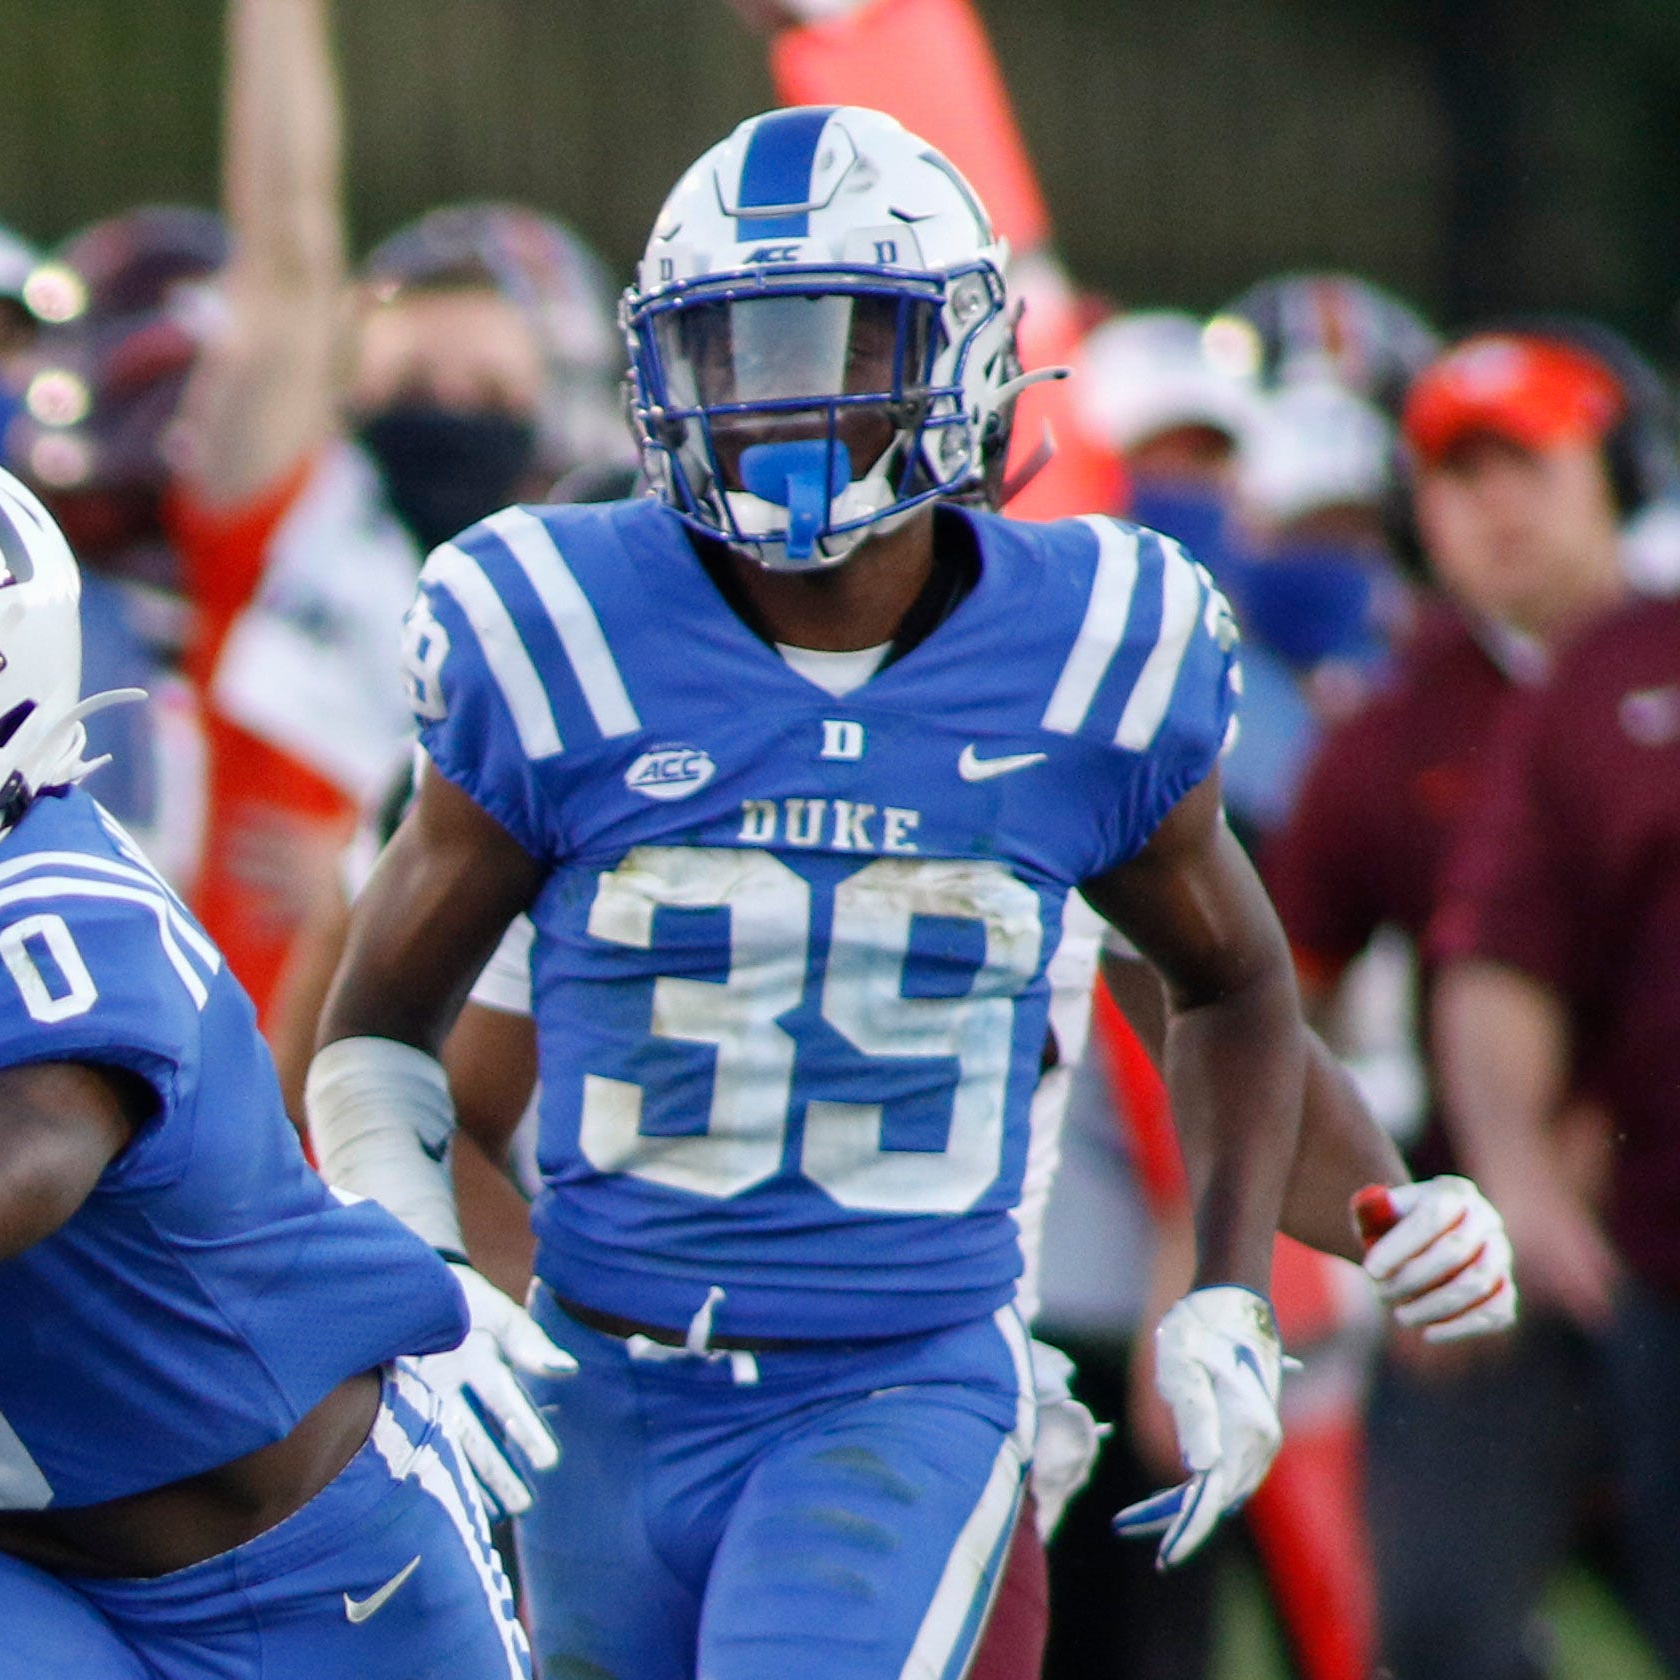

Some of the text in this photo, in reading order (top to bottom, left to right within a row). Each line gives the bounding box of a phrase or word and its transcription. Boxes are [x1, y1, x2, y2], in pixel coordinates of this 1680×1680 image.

[742, 244, 801, 265] ACC
[820, 718, 865, 761] D
[638, 756, 704, 782] ACC
[738, 799, 920, 854] DUKE
[580, 845, 1043, 1215] 39
